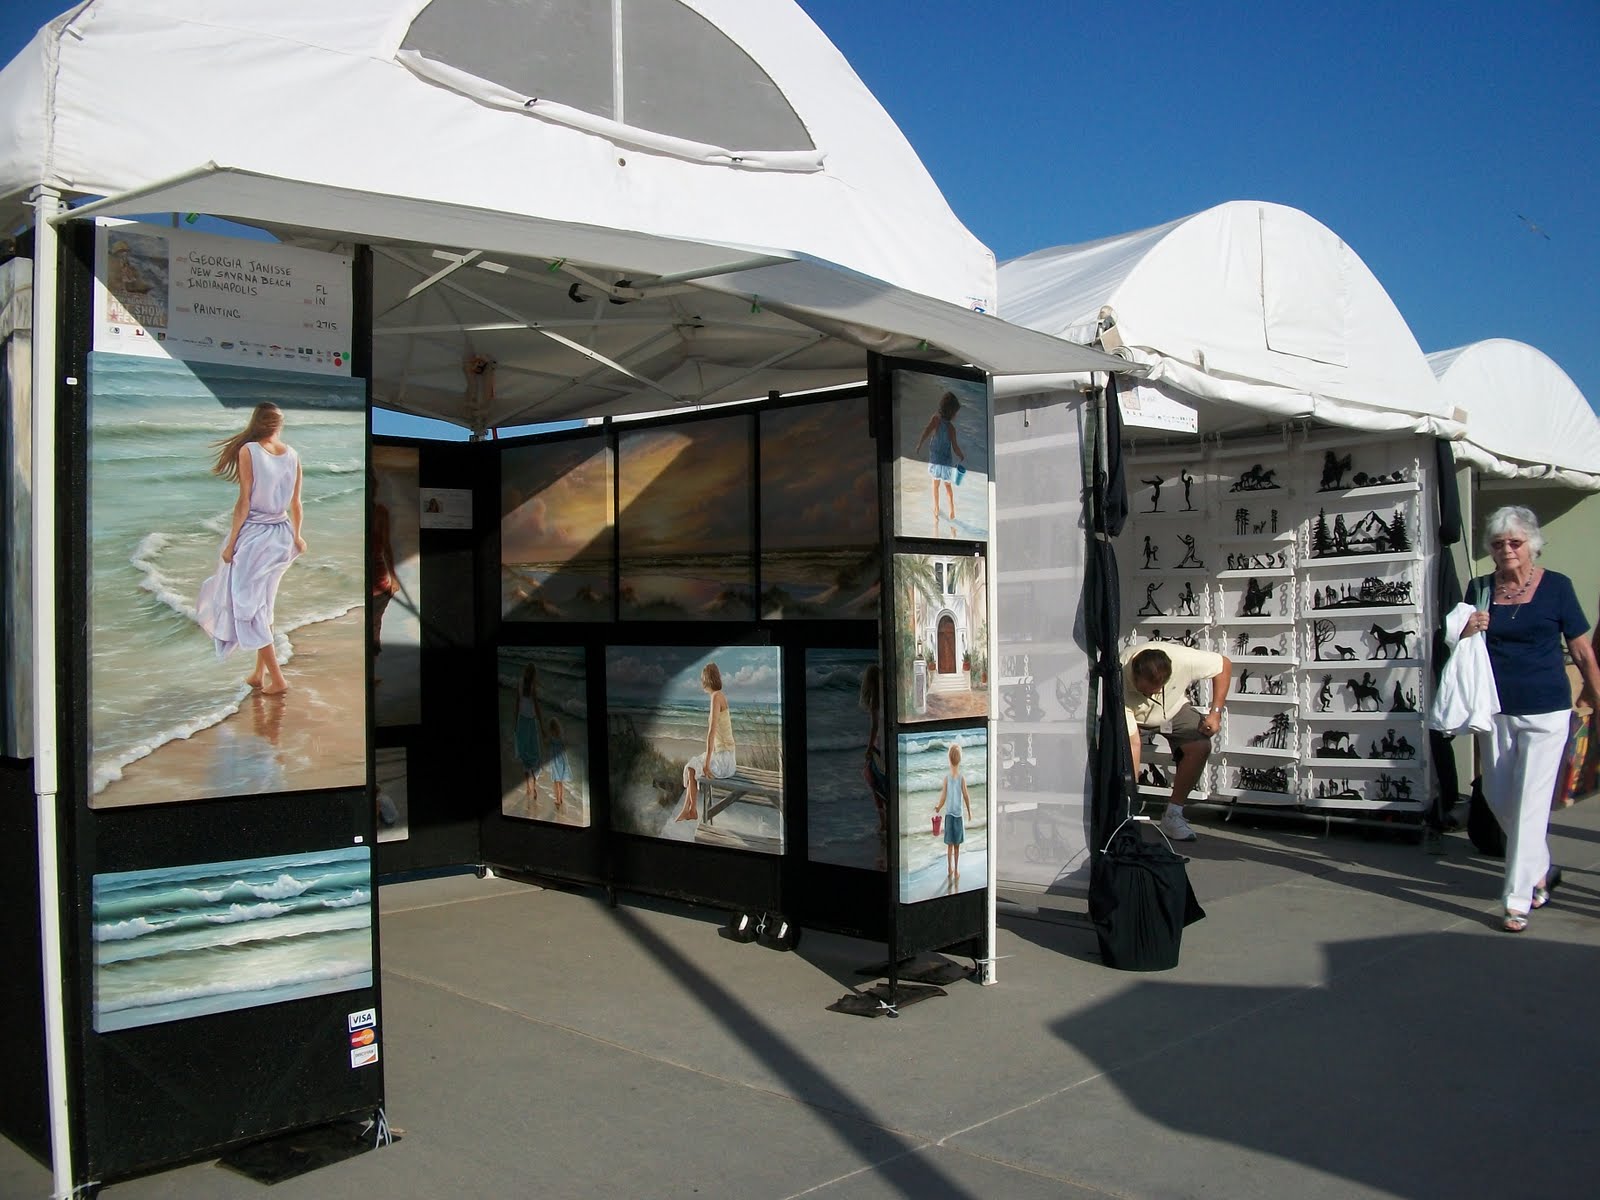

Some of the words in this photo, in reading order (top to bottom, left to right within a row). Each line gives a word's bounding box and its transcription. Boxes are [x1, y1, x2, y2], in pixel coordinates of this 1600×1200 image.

[189, 251, 242, 269] GEORGIA
[249, 260, 292, 276] JANISSE
[190, 266, 211, 277] NEW
[214, 270, 258, 284] SMYRNA
[261, 276, 291, 288] BEACH
[187, 278, 258, 297] INDIANAPOLIS
[315, 284, 328, 295] FL
[315, 296, 326, 306] IN
[193, 302, 241, 319] PAINTING
[116, 313, 166, 327] FESTIVAL
[315, 319, 338, 331] 2715
[353, 1013, 372, 1024] VISA
